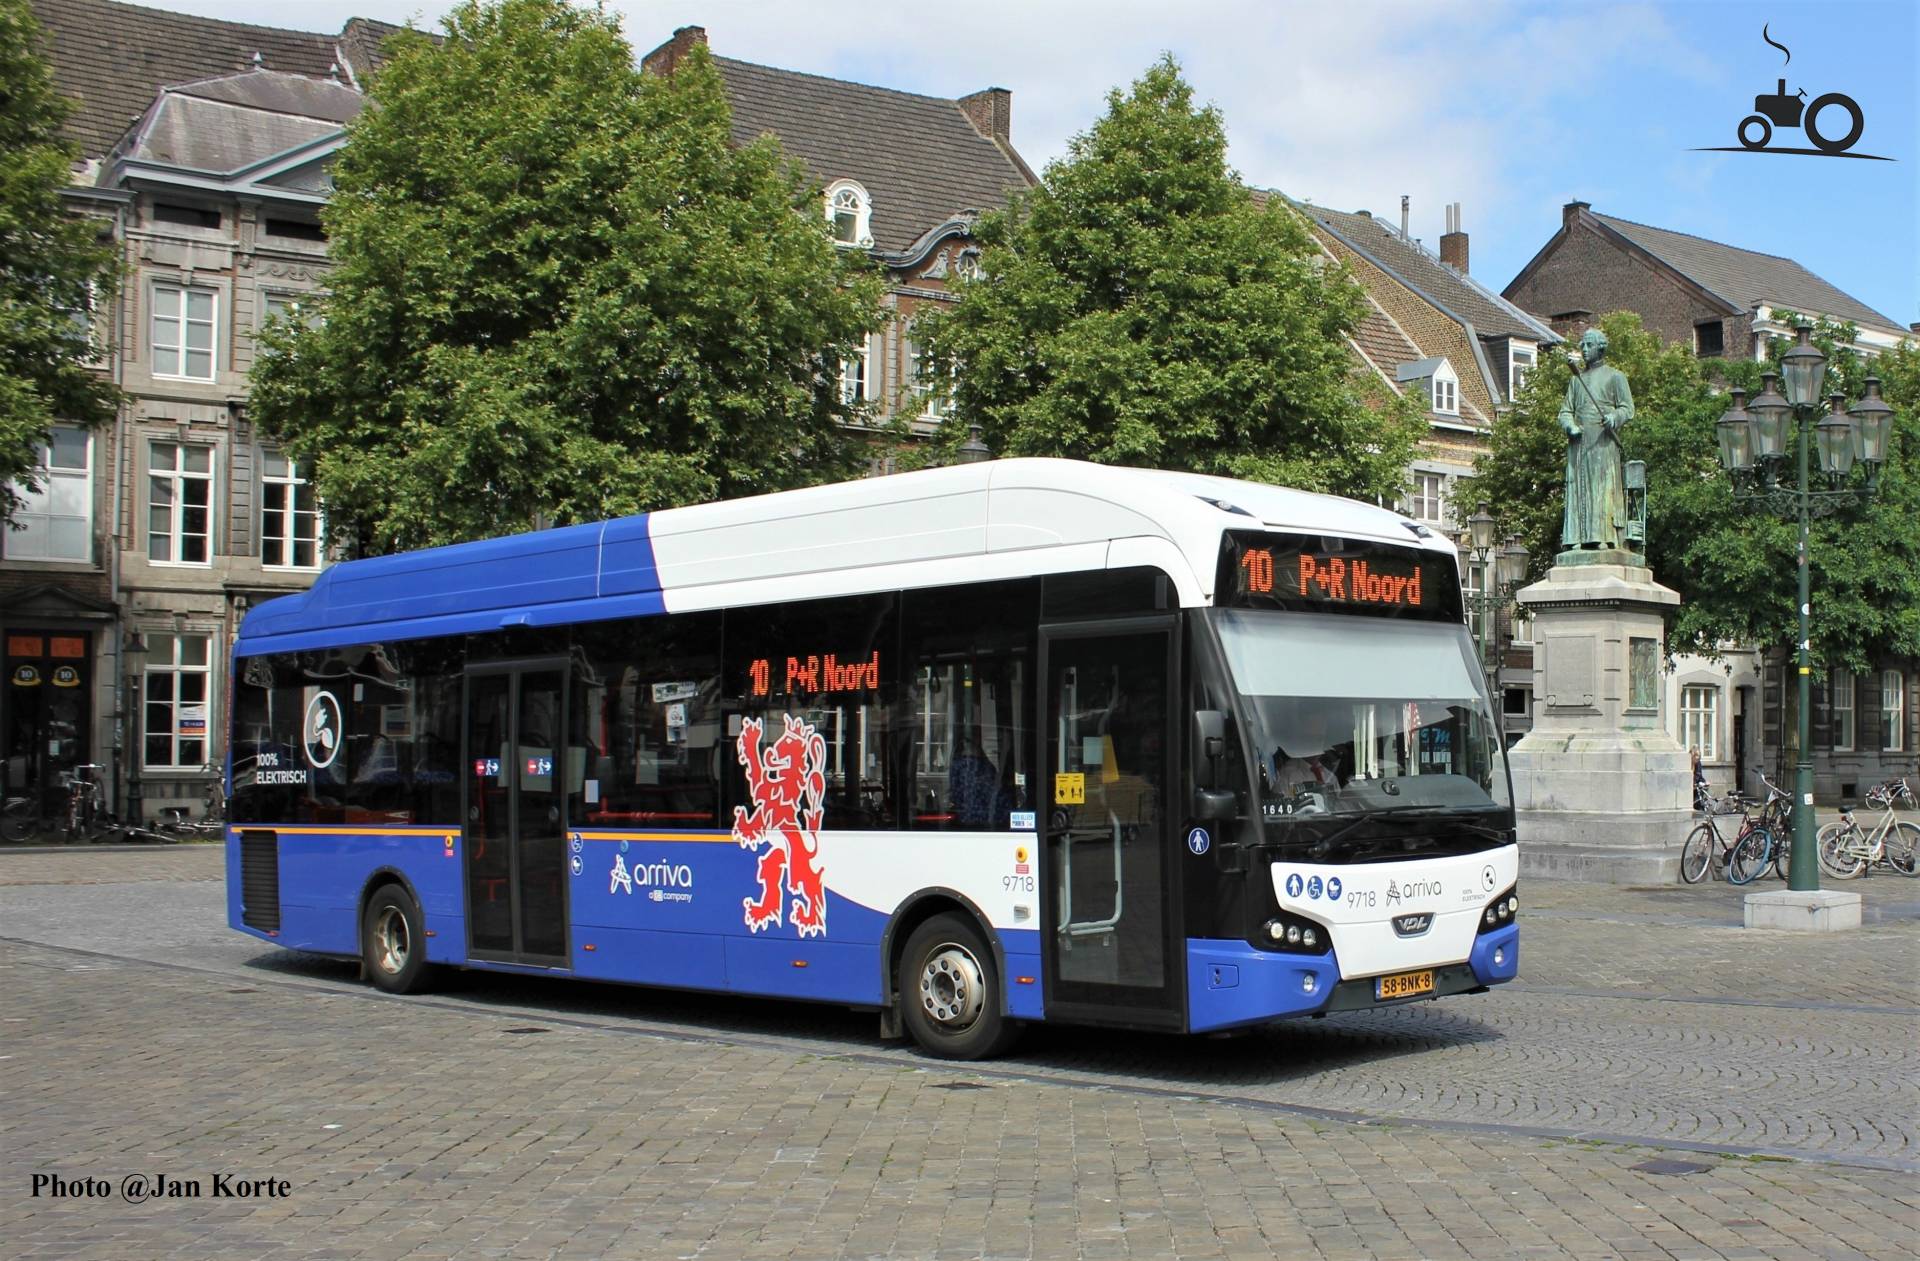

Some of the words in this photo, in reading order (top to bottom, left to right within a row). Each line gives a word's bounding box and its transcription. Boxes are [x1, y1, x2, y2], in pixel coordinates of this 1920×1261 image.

[1241, 549, 1273, 593] 10
[1300, 554, 1345, 599] P+R
[1352, 560, 1421, 605] Noord
[749, 659, 769, 696] 10
[786, 655, 819, 693] P+R
[823, 651, 878, 691] Noord
[256, 752, 278, 767] 100%
[256, 770, 307, 785] ELEKTRISCH
[1262, 804, 1293, 815] 1640
[634, 858, 692, 888] arriva
[1002, 875, 1034, 892] 9718
[1402, 878, 1443, 899] arriva
[663, 892, 693, 903] company
[1347, 890, 1377, 909] 9718
[1398, 916, 1428, 931] VDL
[1383, 973, 1431, 994] 58-BNK-8
